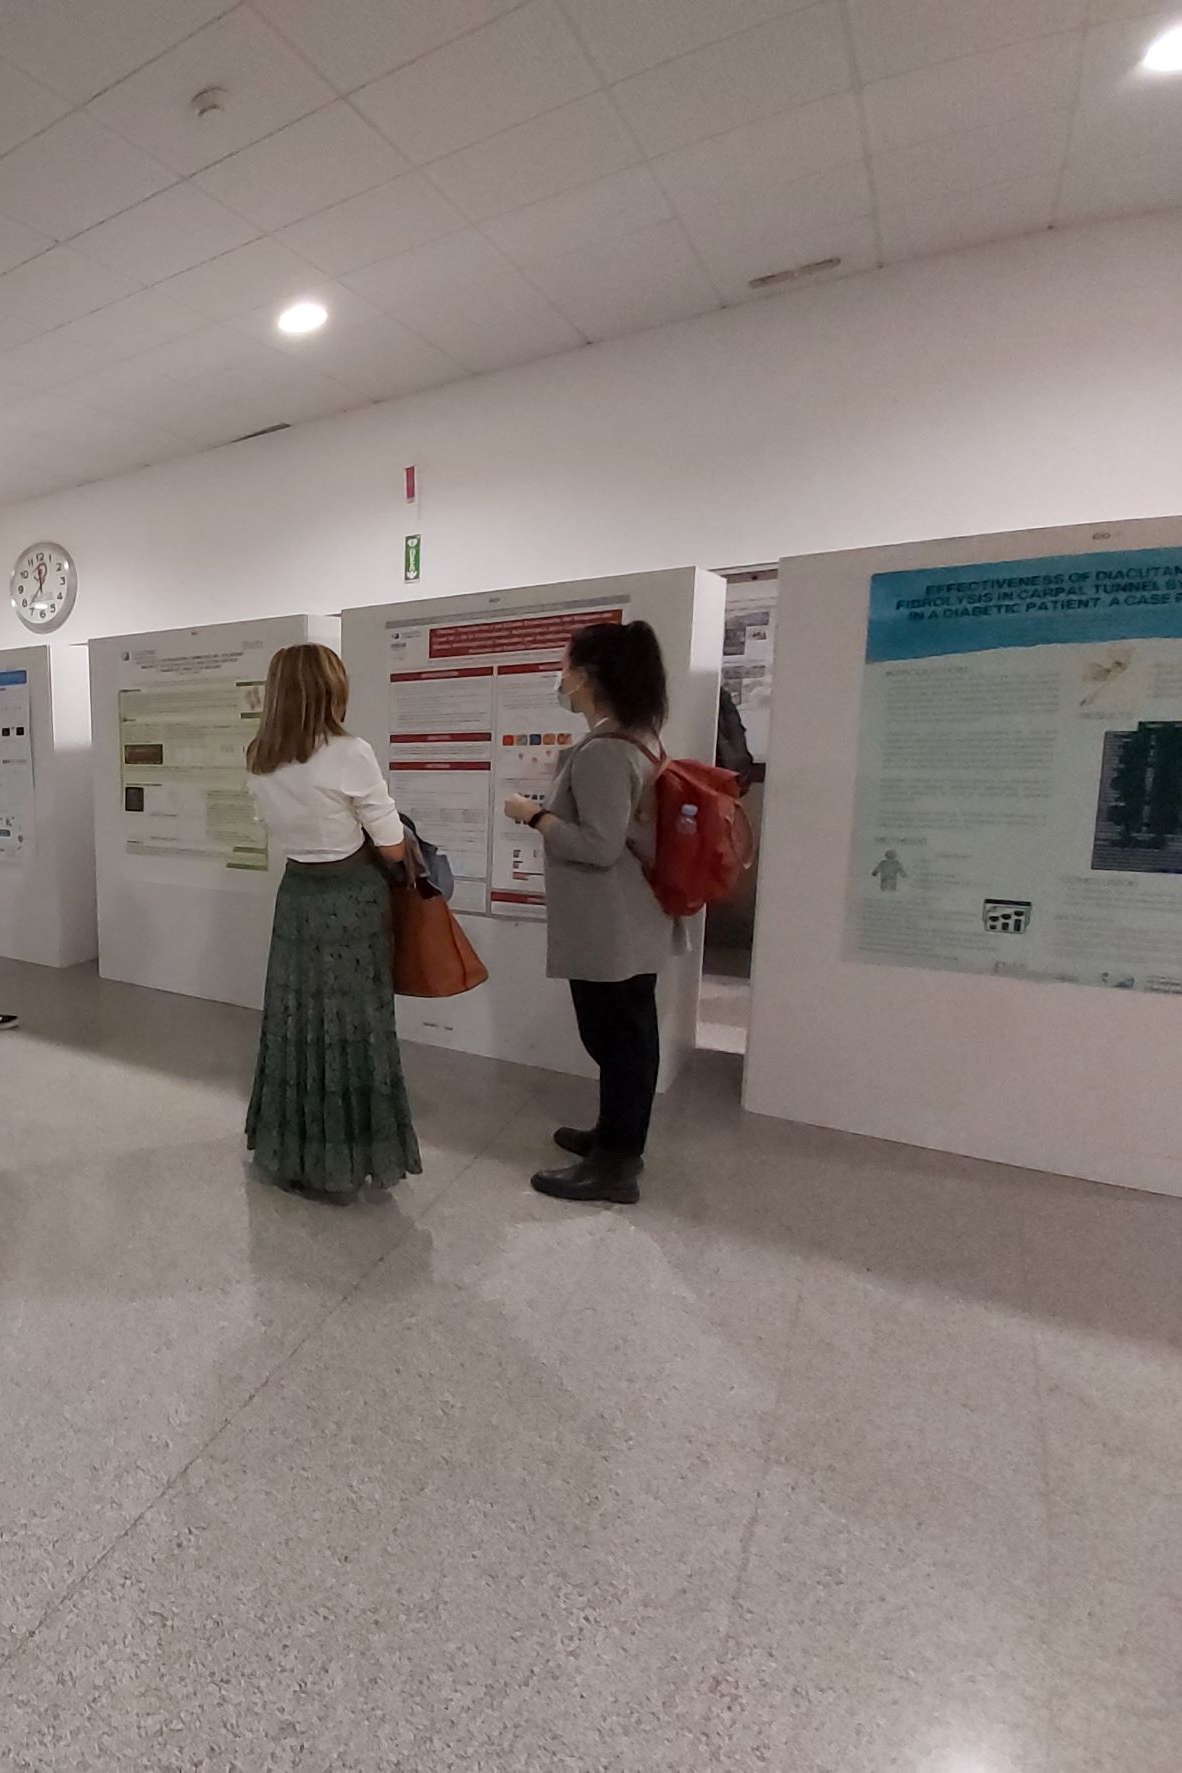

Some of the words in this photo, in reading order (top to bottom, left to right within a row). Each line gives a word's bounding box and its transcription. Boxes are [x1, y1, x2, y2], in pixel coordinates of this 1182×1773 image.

[36, 553, 44, 561] 12
[49, 554, 52, 563] 1
[28, 558, 34, 567] 11
[56, 563, 62, 572] 2
[20, 570, 28, 579] 10
[60, 576, 65, 585] 3
[925, 573, 1064, 595] EFFECTIVENESS
[1068, 571, 1091, 583] OF
[18, 585, 24, 594] 9
[57, 592, 63, 600] 4
[896, 592, 993, 610] FIBROLYSIS
[998, 591, 1013, 601] IN
[1019, 585, 1088, 600] CARPAL
[1094, 580, 1160, 594] TUNNEL
[22, 598, 27, 607] 8
[909, 610, 924, 621] IN
[928, 610, 938, 620] A
[943, 603, 1019, 619] DIABETIC
[1108, 597, 1120, 607] A
[1124, 593, 1171, 606] CASE
[29, 607, 35, 616] 7
[50, 604, 55, 613] 5
[40, 610, 46, 618] 6
